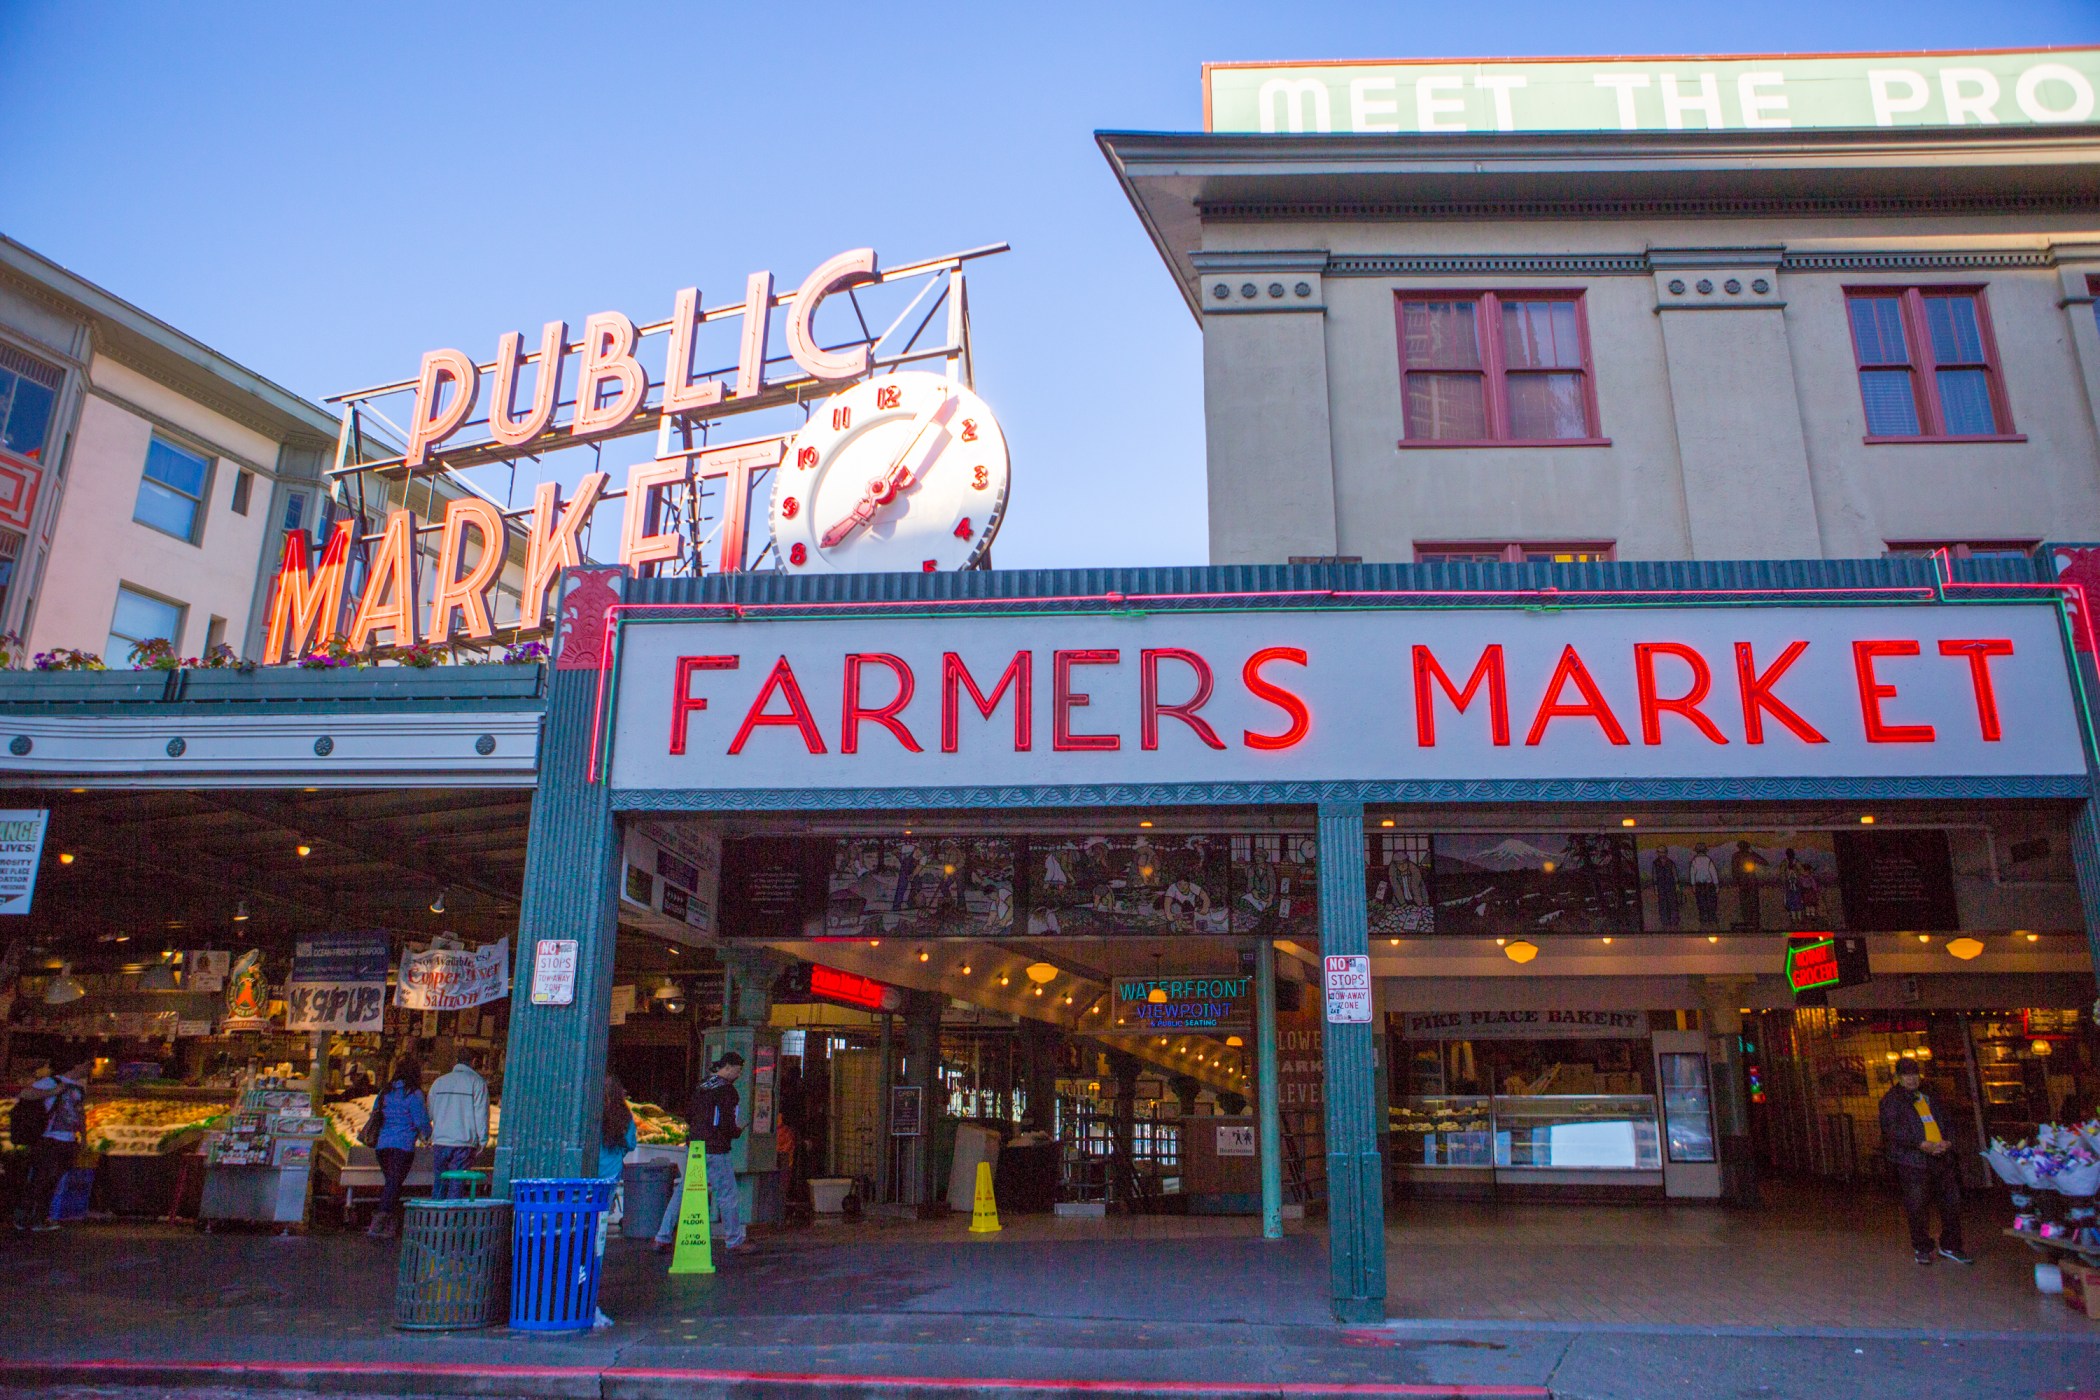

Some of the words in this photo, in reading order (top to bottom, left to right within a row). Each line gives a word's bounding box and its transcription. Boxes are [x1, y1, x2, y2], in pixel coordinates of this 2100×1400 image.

[1258, 75, 1528, 133] MEET
[1594, 71, 1792, 130] THE
[1867, 63, 2095, 126] PRO
[405, 248, 877, 468] PUBLIC
[877, 385, 903, 411] 12
[832, 406, 851, 431] 11
[961, 418, 978, 443] 2
[797, 446, 820, 471] 10
[971, 465, 989, 491] 3
[782, 496, 800, 520] 9
[953, 517, 974, 542] 4
[263, 436, 786, 665] MARKET
[789, 542, 808, 567] 8
[669, 647, 1310, 755] FARMERS
[1411, 639, 2014, 747] MARKET
[541, 942, 557, 954] NO
[541, 958, 571, 969] STOPS
[1329, 957, 1346, 971] NO
[1792, 960, 1839, 988] GROCERY
[408, 966, 461, 990] Copper
[1119, 979, 1248, 1001] WATERFRONT
[1331, 974, 1365, 986] STOPS
[423, 988, 479, 1008] Salmon
[1333, 991, 1366, 1000] OW-AWAY
[1339, 1001, 1359, 1010] ZONE
[1136, 1003, 1232, 1019] VIEWPOINT
[1184, 1019, 1217, 1027] SEATING
[1412, 1012, 1462, 1031] PIKE
[1471, 1010, 1539, 1025] PLACE
[1548, 1010, 1639, 1029] BAKERY
